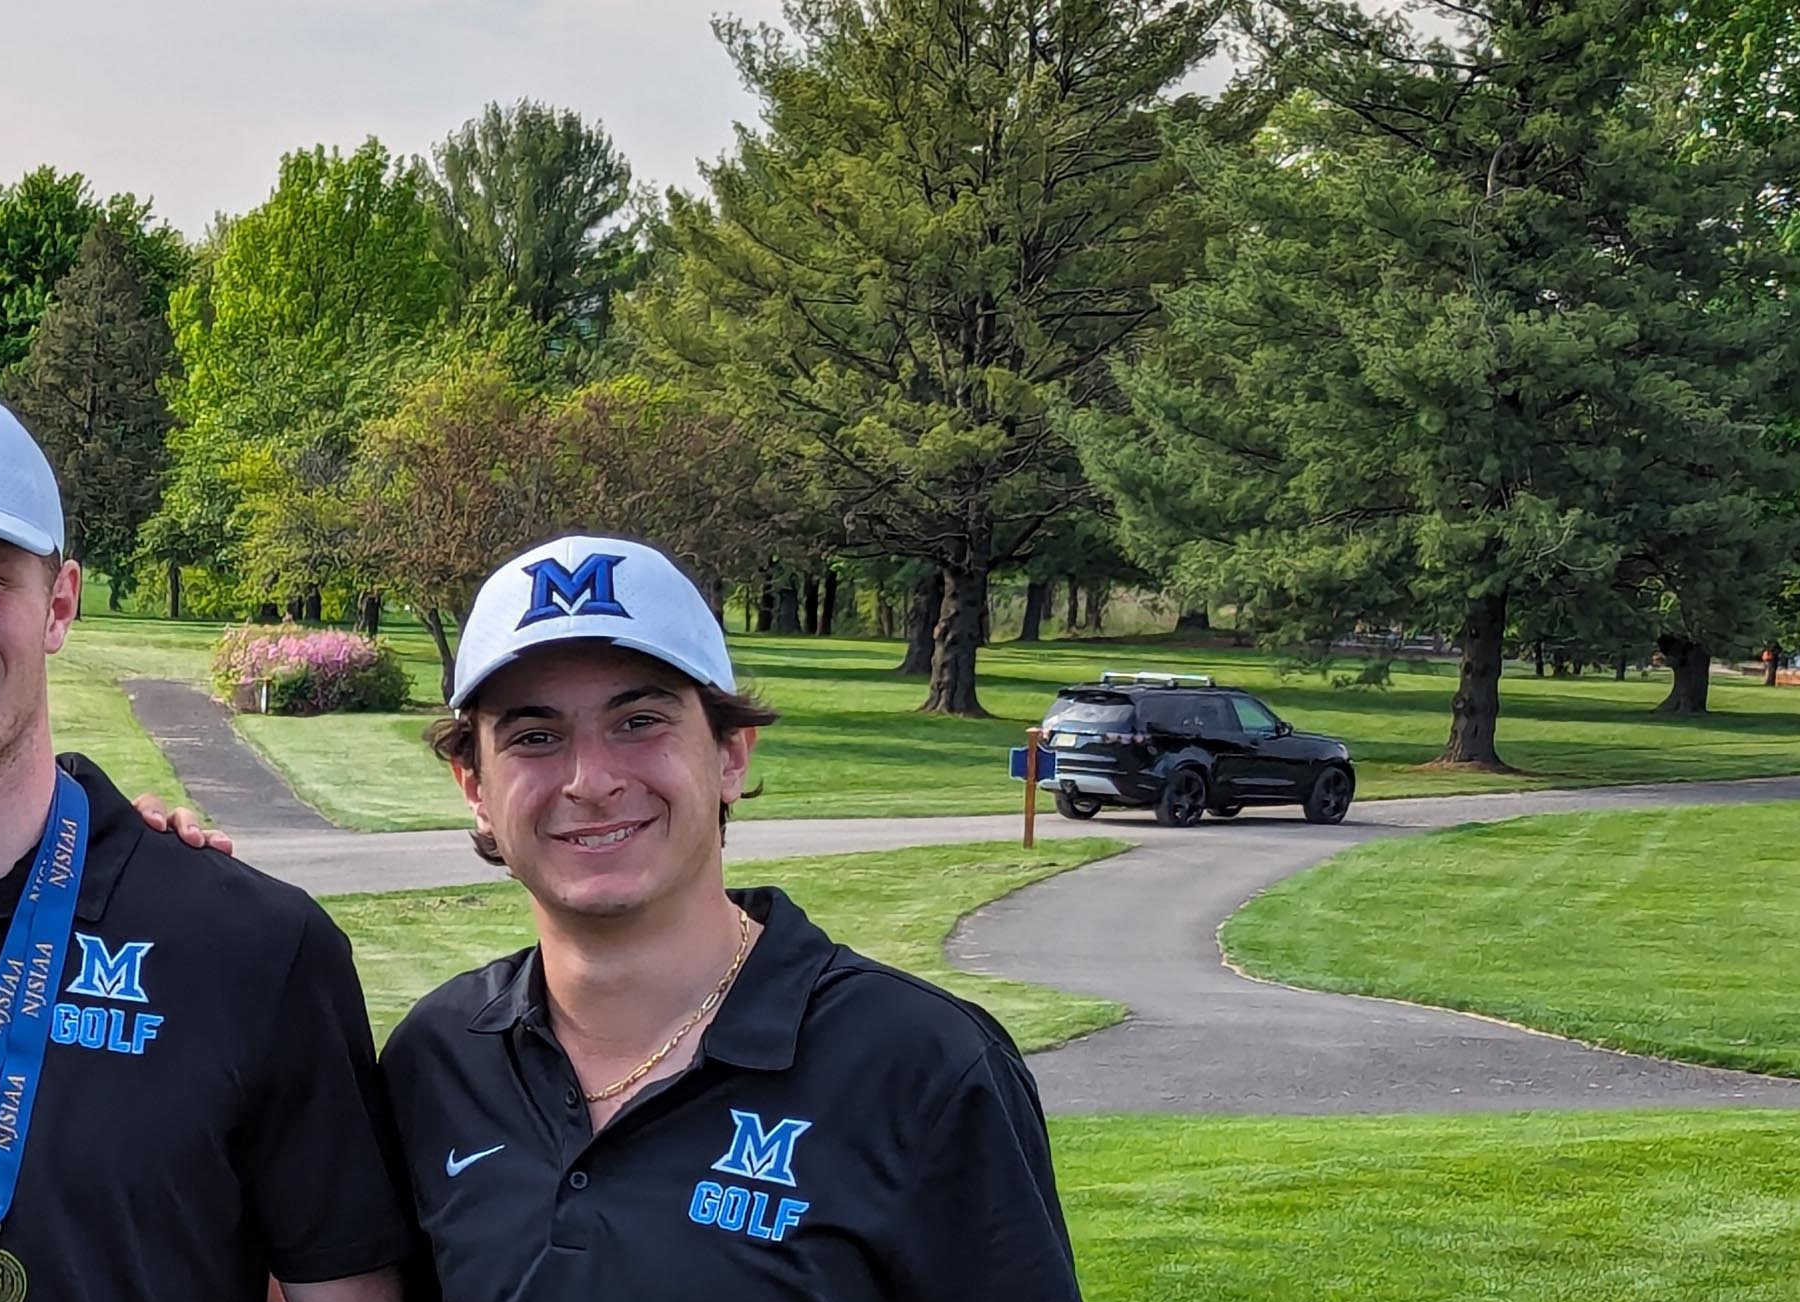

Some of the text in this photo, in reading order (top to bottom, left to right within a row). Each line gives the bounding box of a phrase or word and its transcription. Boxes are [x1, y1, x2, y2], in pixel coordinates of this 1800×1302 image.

[514, 553, 634, 632] M
[48, 818, 78, 888] NJSIAA
[21, 942, 53, 1018] NJSIAA
[65, 931, 154, 1003] M
[49, 1004, 165, 1054] GOLF
[710, 1108, 813, 1187] M
[688, 1180, 810, 1242] GOLF
